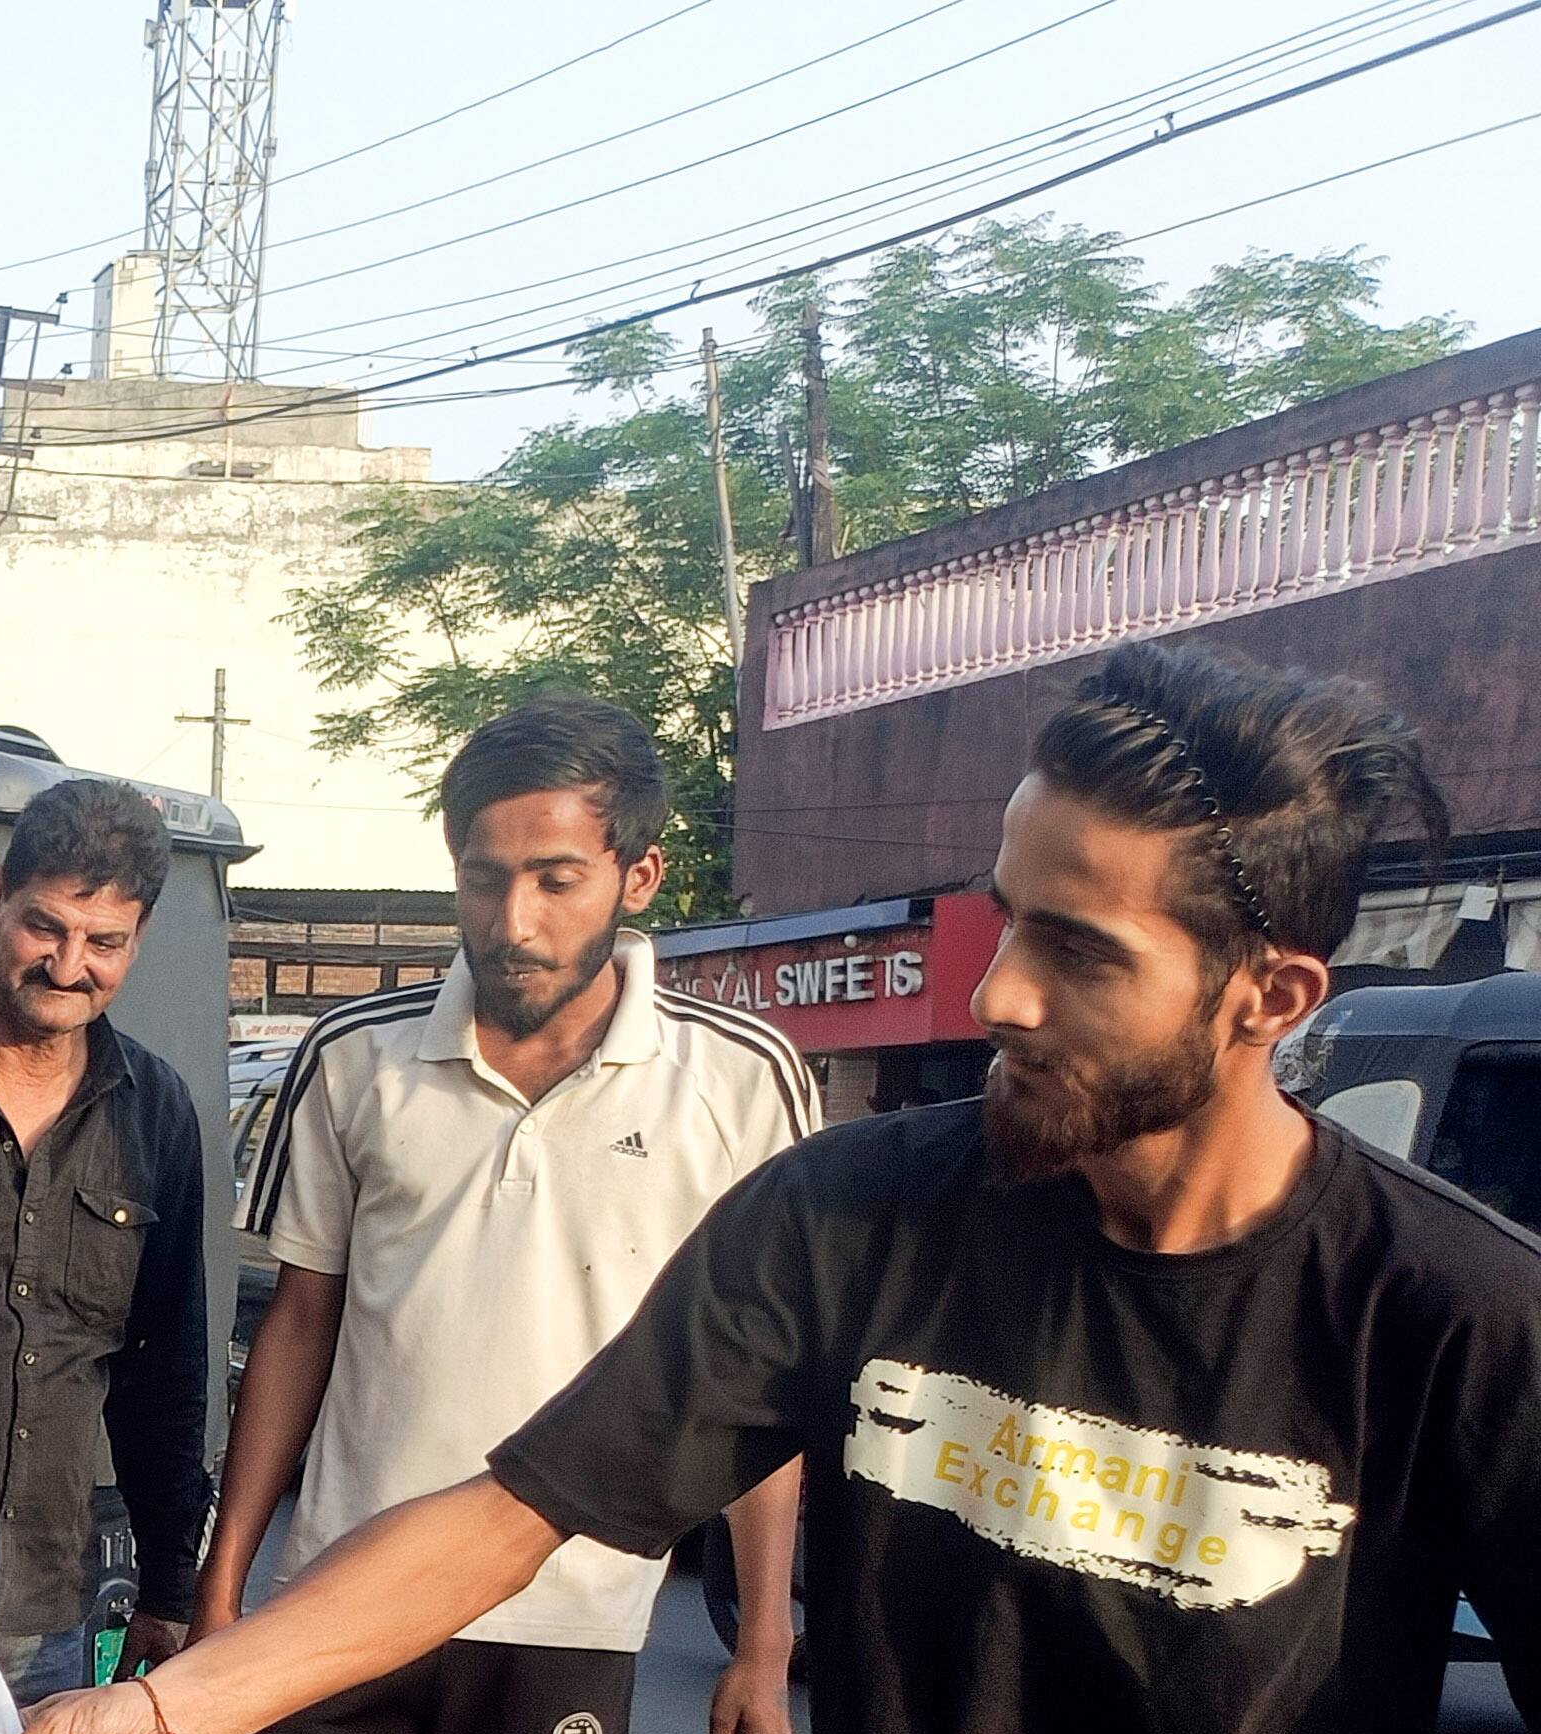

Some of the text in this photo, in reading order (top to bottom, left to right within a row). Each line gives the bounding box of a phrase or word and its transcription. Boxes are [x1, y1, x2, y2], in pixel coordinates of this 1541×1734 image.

[609, 1144, 649, 1159] adidas
[933, 1441, 1228, 1565] Exchange
[986, 1412, 1191, 1507] Armani
